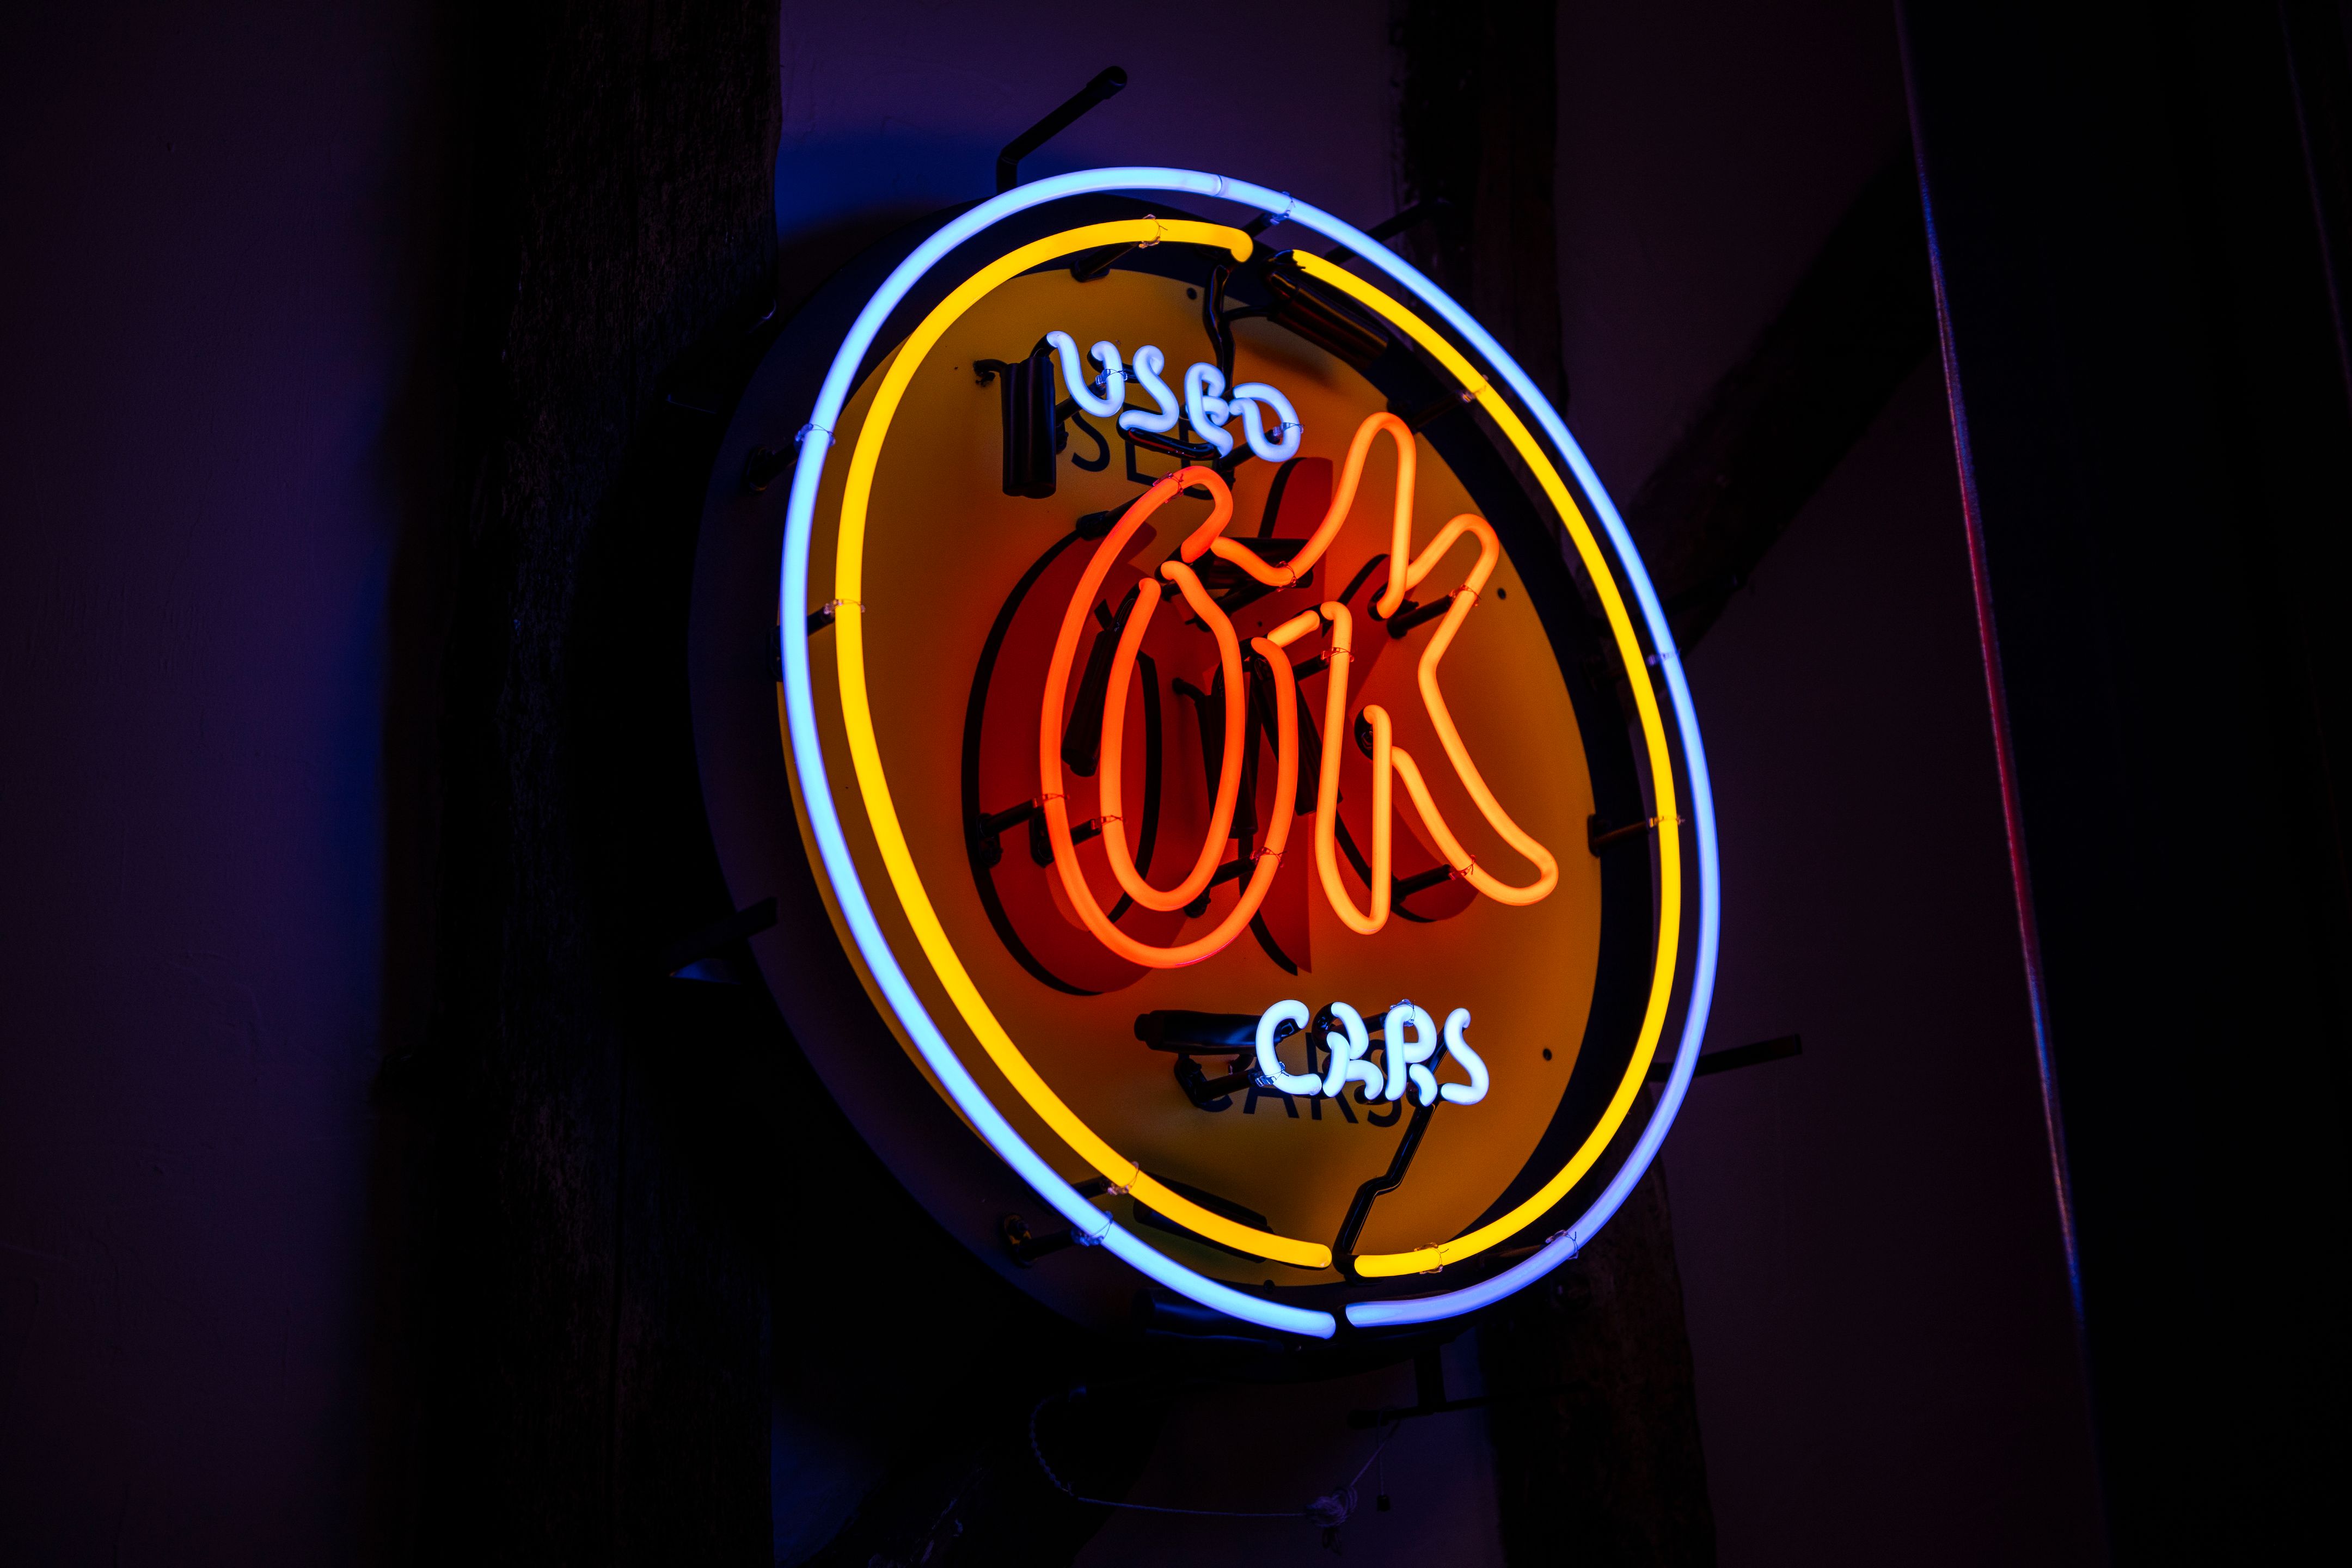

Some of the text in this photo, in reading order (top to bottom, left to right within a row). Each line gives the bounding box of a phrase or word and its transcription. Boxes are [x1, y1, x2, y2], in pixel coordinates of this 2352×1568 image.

[1046, 330, 1302, 463] USED
[1040, 412, 1559, 969] OK
[1255, 999, 1490, 1106] CARS
